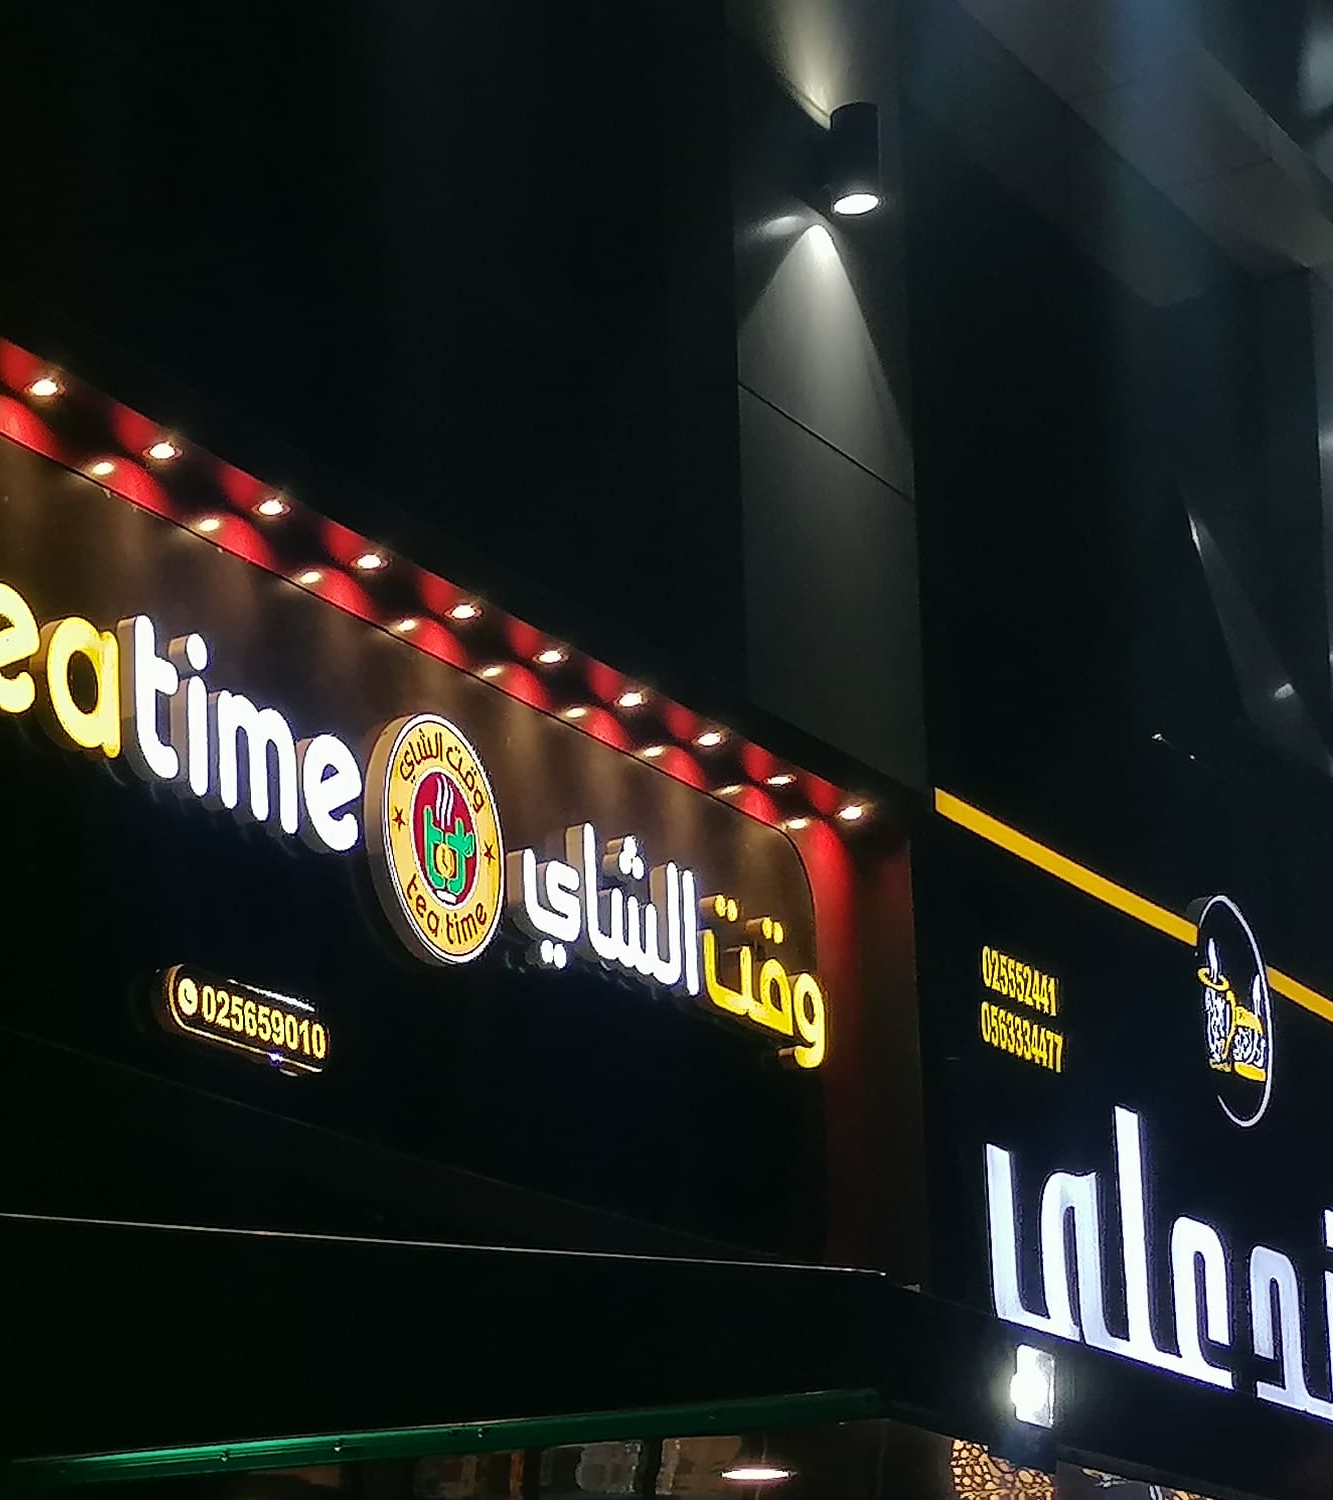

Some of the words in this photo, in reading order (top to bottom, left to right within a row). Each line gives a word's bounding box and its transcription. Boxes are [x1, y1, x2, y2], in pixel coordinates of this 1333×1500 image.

[399, 728, 444, 784] الشاي
[446, 744, 485, 814] وقت
[406, 873, 440, 938] tea
[446, 902, 487, 946] time
[523, 821, 700, 997] الشاي
[701, 895, 826, 1070] وقت
[982, 945, 1057, 1017] 025552441
[201, 984, 326, 1060] 025659010
[981, 1001, 1063, 1073] 0563334477
